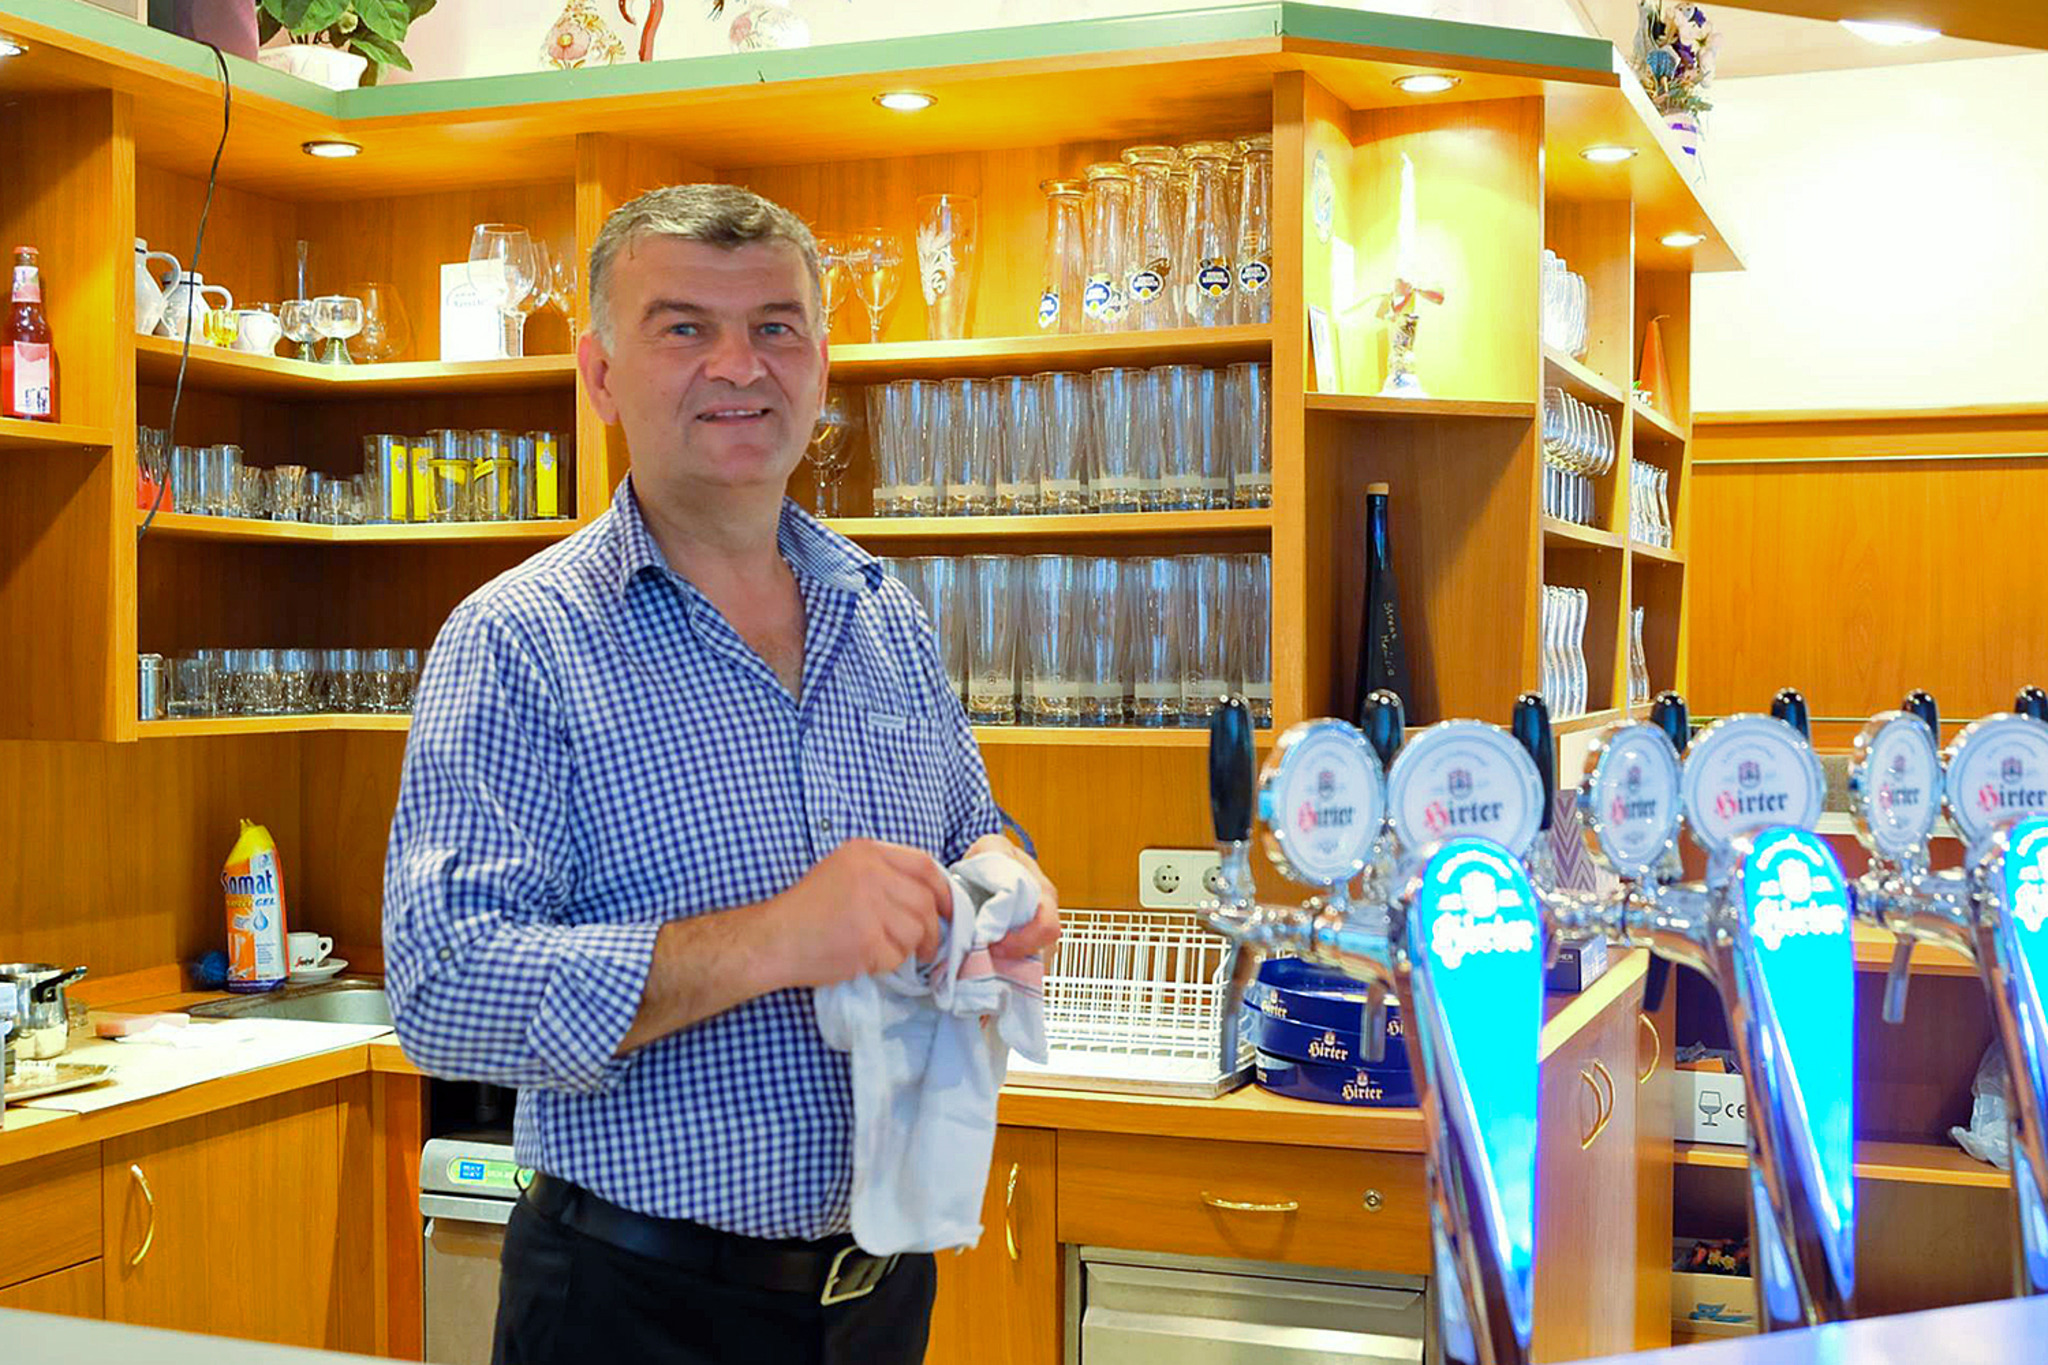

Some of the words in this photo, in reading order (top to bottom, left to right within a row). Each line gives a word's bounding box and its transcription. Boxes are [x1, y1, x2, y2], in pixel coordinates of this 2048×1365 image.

[1714, 790, 1788, 821] Hirter
[1976, 783, 2047, 812] Hirter
[1423, 800, 1503, 834] Hirter
[221, 869, 273, 895] Somat
[1308, 1041, 1348, 1061] Hirter
[1342, 1083, 1383, 1101] Hirter
